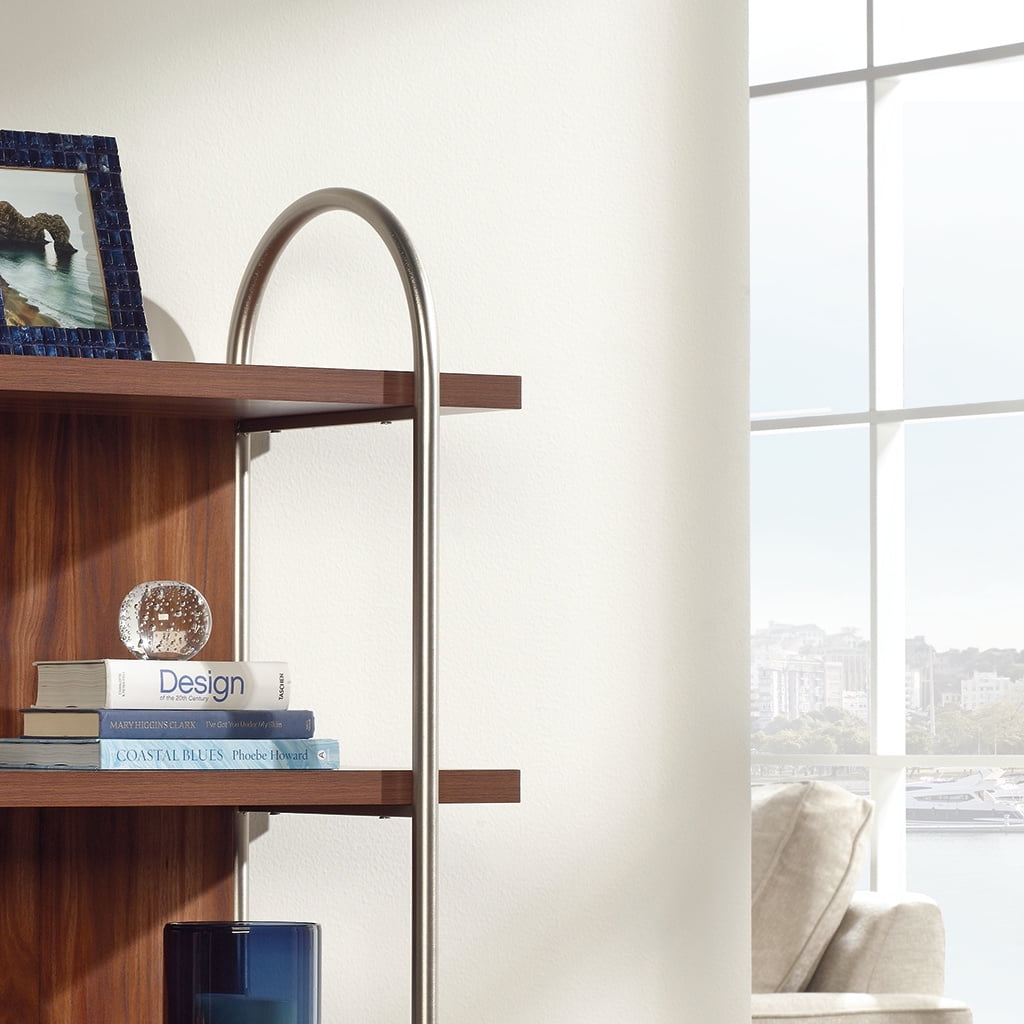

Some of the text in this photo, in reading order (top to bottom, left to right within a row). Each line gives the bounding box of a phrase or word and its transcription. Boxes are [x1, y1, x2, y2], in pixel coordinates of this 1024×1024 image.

[159, 669, 244, 702] Design
[188, 695, 209, 703] Century
[110, 721, 196, 729] MARY HIGGINS CLARK
[116, 749, 224, 762] COASTAL BLUES
[232, 749, 308, 761] Phoebe Howard
